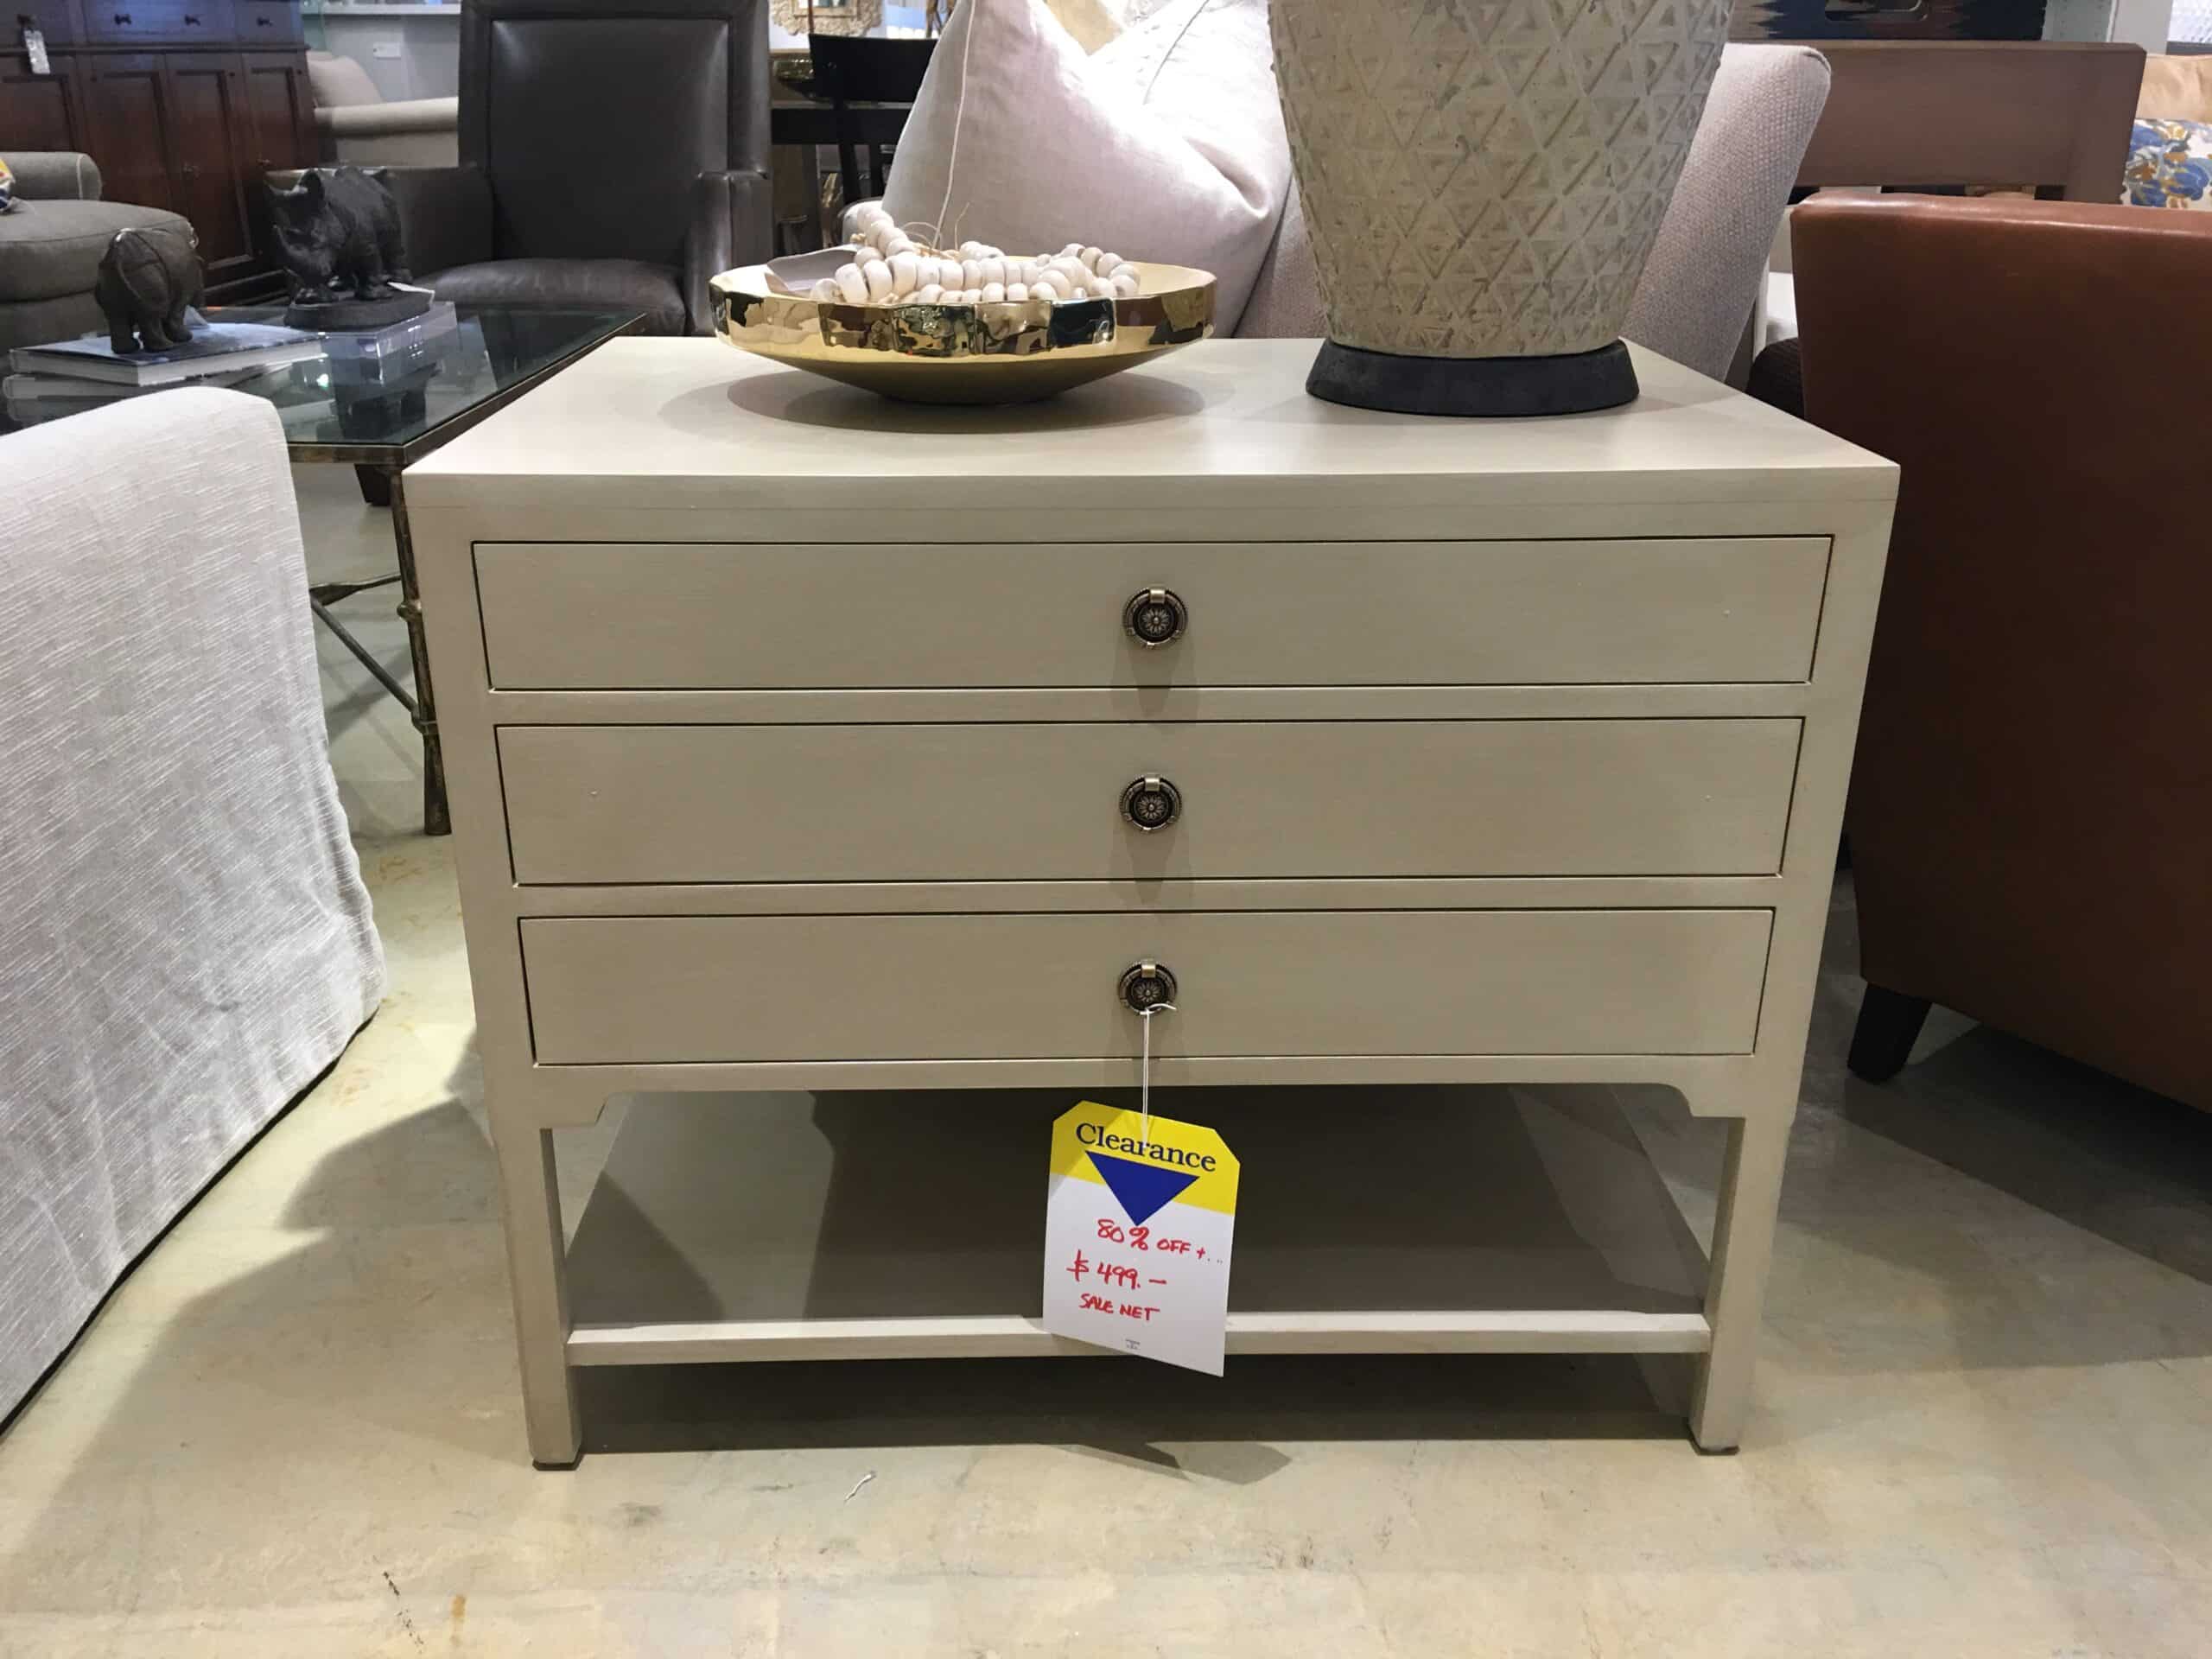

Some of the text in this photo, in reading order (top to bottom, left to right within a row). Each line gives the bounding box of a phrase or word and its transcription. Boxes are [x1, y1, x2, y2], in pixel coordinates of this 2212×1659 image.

[1075, 1122, 1217, 1173] Clearance
[1096, 1218, 1150, 1251] 80%
[1156, 1237, 1192, 1255] OFF
[1078, 1293, 1160, 1321] SALE NET
